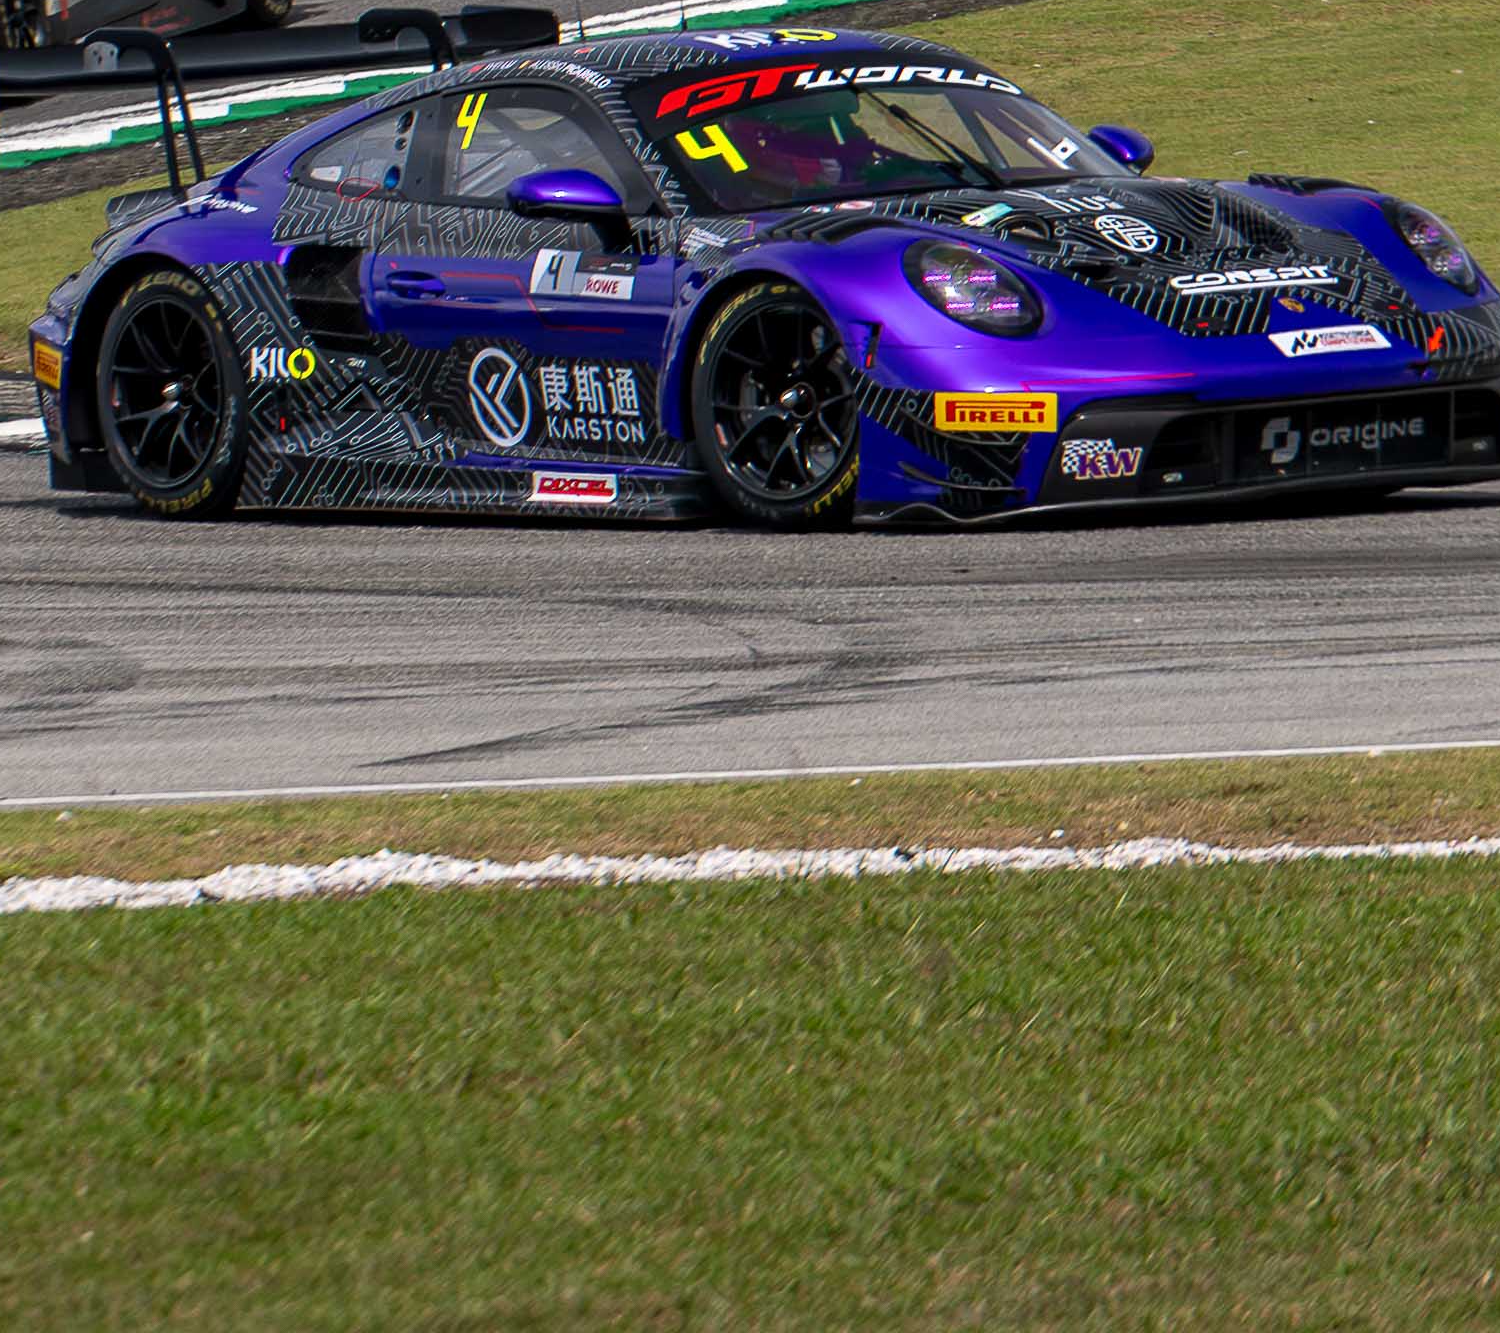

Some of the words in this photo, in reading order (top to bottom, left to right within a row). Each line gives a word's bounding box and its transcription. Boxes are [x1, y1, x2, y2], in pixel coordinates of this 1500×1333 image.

[793, 64, 1024, 95] WORLD
[456, 92, 488, 150] 4
[674, 124, 749, 174] 4
[585, 279, 620, 295] ROWE
[1170, 264, 1330, 290] CONSPIT
[249, 346, 316, 381] KILO
[539, 363, 642, 417] 康斯通
[944, 399, 1046, 426] PIRELLI
[547, 415, 646, 444] KARSTON
[1076, 445, 1143, 480] KW
